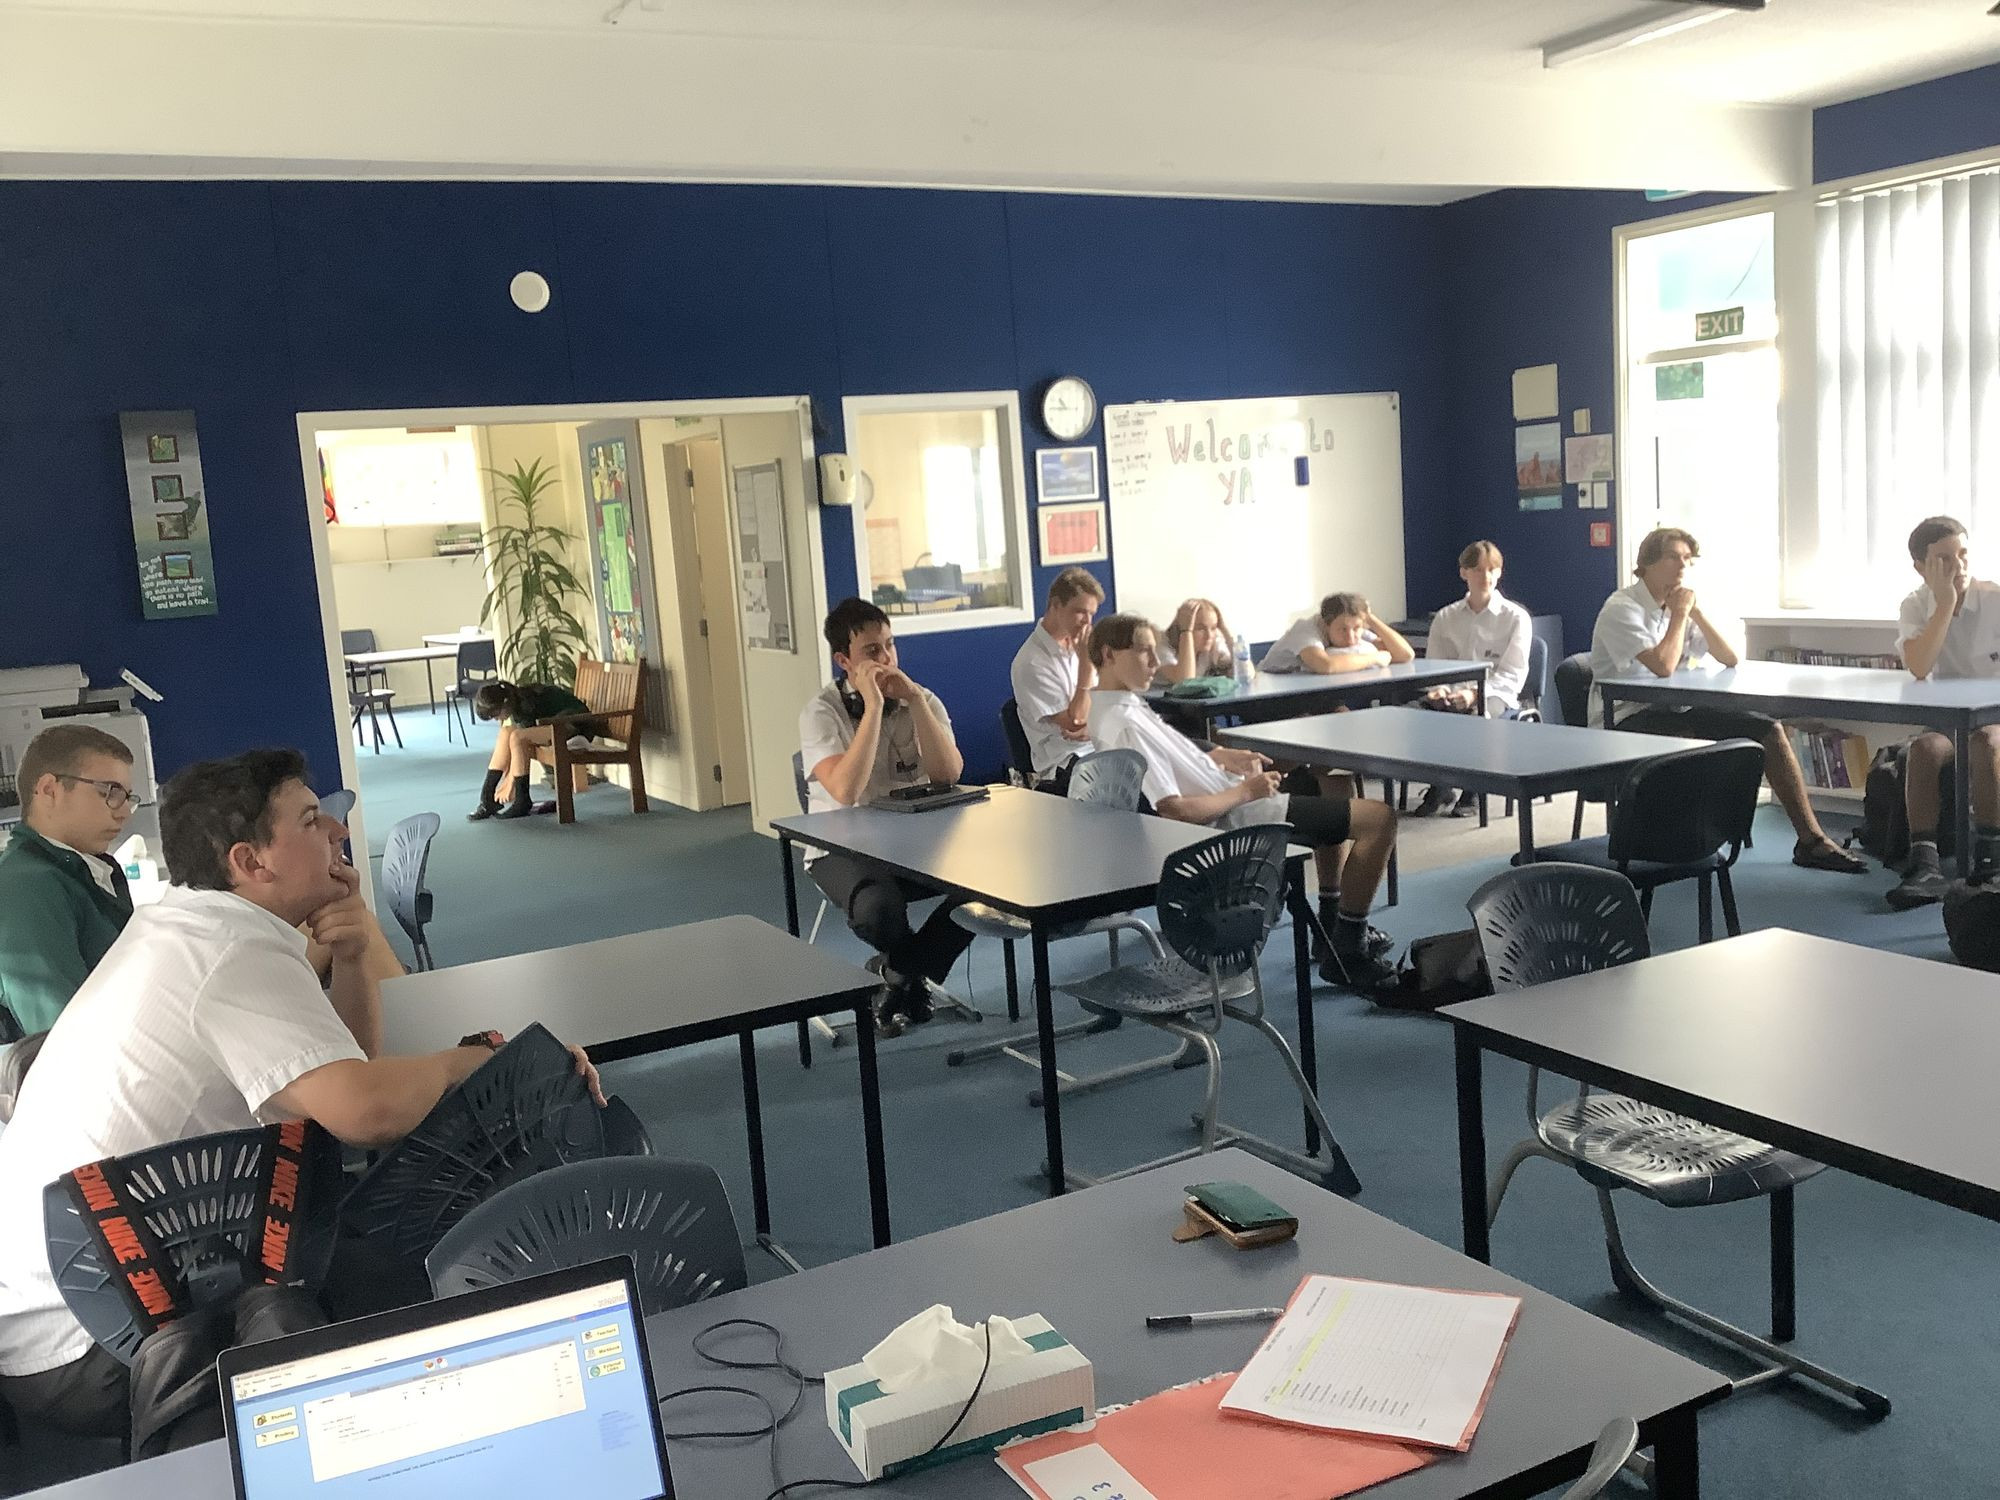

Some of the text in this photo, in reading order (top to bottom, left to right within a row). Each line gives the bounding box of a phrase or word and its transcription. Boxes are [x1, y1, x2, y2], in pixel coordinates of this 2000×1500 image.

[1697, 311, 1743, 337] EXIT
[1164, 415, 1288, 465] Welco
[1308, 417, 1335, 453] to
[73, 1163, 119, 1212] NIKE
[269, 1156, 299, 1212] NIKE
[99, 1216, 147, 1265] NIKE
[261, 1215, 290, 1272] NIKE
[127, 1268, 176, 1316] NIKE
